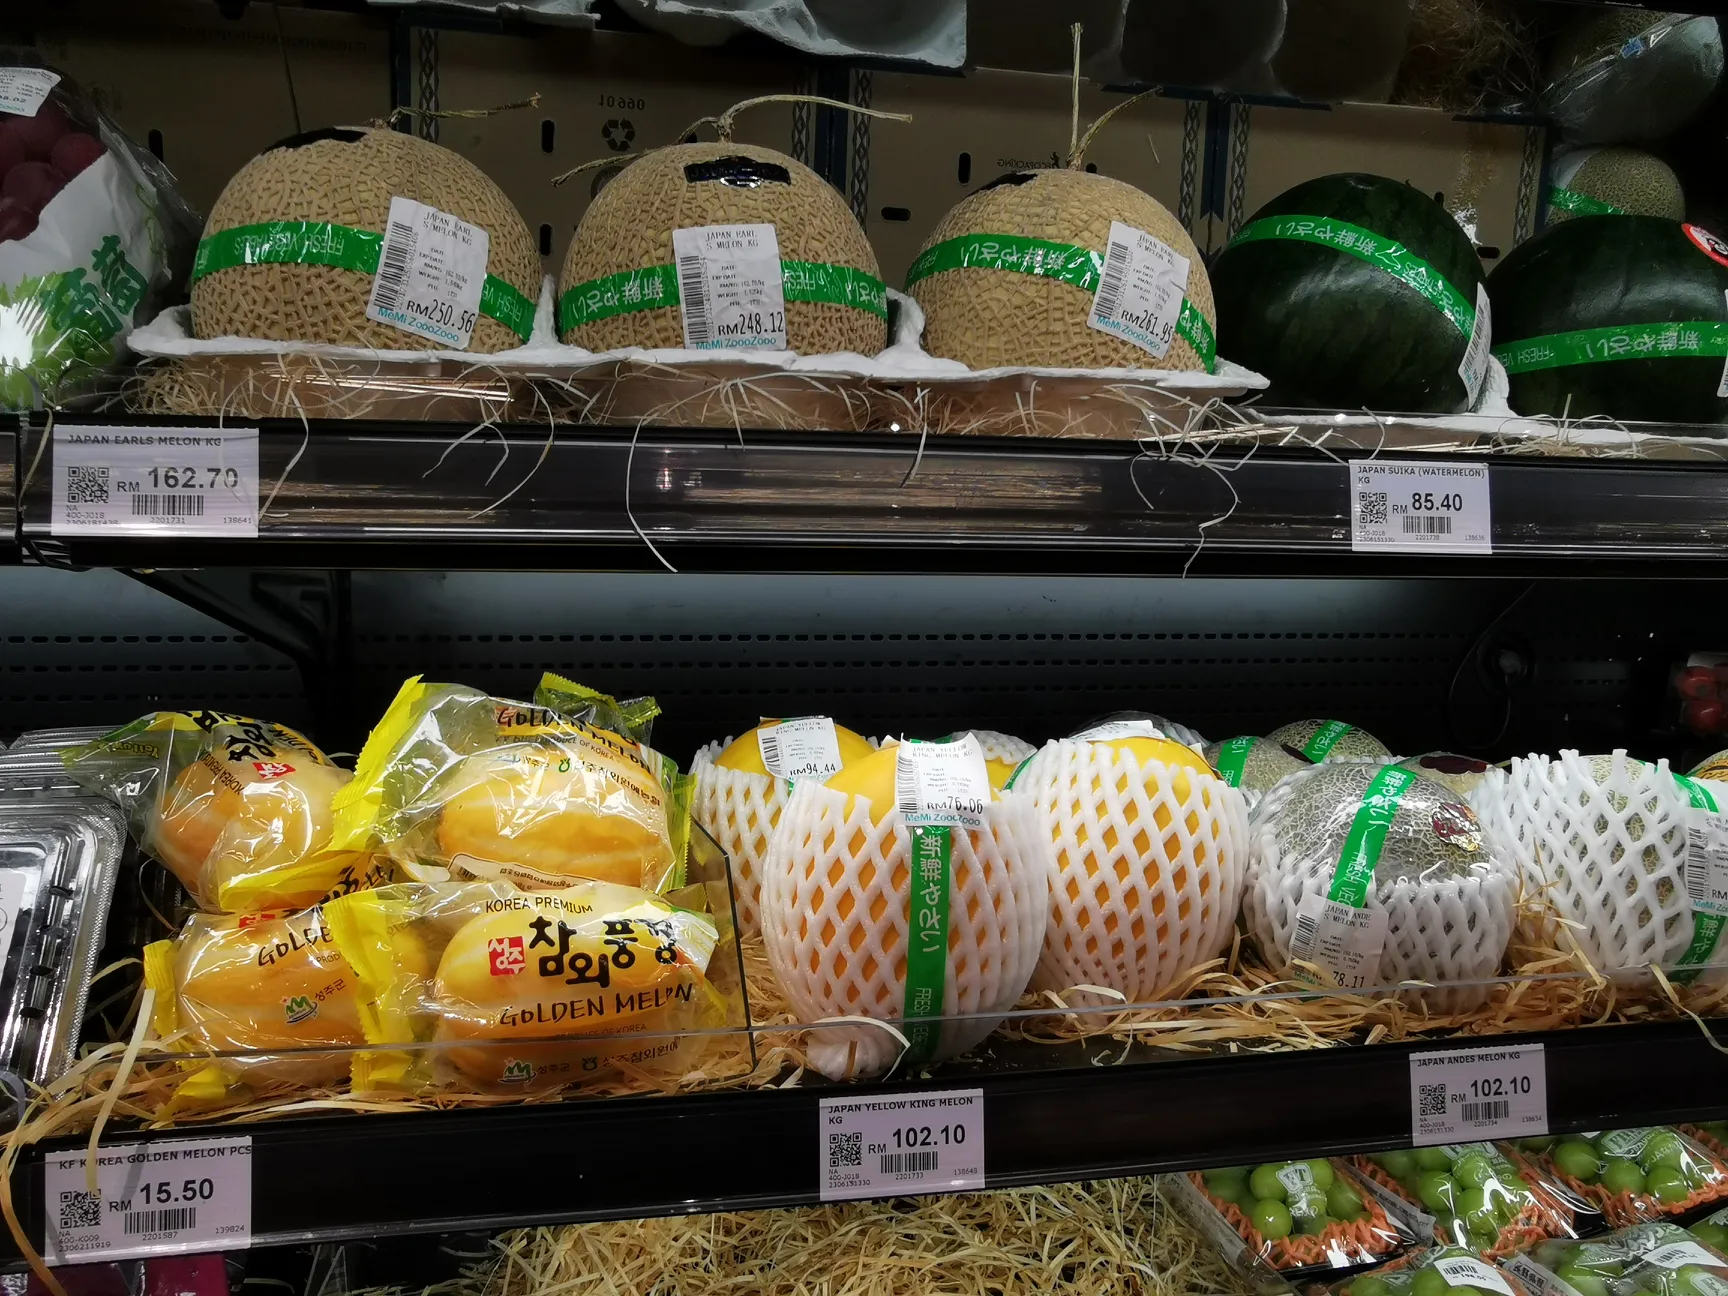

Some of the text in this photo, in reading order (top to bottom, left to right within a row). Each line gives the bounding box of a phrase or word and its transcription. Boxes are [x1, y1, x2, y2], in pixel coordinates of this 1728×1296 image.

[424, 211, 450, 227] JAPAN
[432, 222, 458, 240] MELON
[706, 231, 732, 242] JAPAN
[1276, 221, 1378, 256] 新鮮やさい
[716, 240, 743, 250] MELON
[748, 239, 759, 247] KG
[406, 299, 476, 334] RM250.56
[718, 311, 784, 336] RM248.12
[1518, 345, 1550, 364] FRESH
[68, 434, 222, 446] JAPAN EARLS MELON KG
[116, 466, 239, 492] RM 162.70
[1358, 466, 1486, 479] JAPAN SUIKA (WATERMELON)
[1392, 492, 1463, 514] RM 85.40
[590, 746, 615, 760] KOREA
[926, 796, 984, 815] RM76.06
[904, 814, 932, 822] MeMi
[918, 834, 943, 952] 新鮮やさい
[485, 896, 594, 914] KOREA PREMIUM
[1324, 904, 1372, 921] JAPAN ANDE
[1332, 914, 1356, 927] MELON
[257, 925, 334, 968] GOLDE
[500, 998, 605, 1028] GOLDEN
[616, 1024, 648, 1034] KOREA
[1417, 1051, 1520, 1067] JAPAN ANDES MELON KG
[1450, 1076, 1531, 1104] RM 102.10
[828, 1096, 974, 1114] JAPAN YELLOW KING MELON
[828, 1116, 843, 1125] KG
[868, 1124, 966, 1154] RM 102.10
[60, 1144, 252, 1170] KF KREA GOLDEN MELON PCS
[895, 1172, 924, 1180] 2201733
[109, 1178, 214, 1212] RM 15.50
[142, 1231, 179, 1242] 2201587
[216, 1224, 245, 1234] 139824
